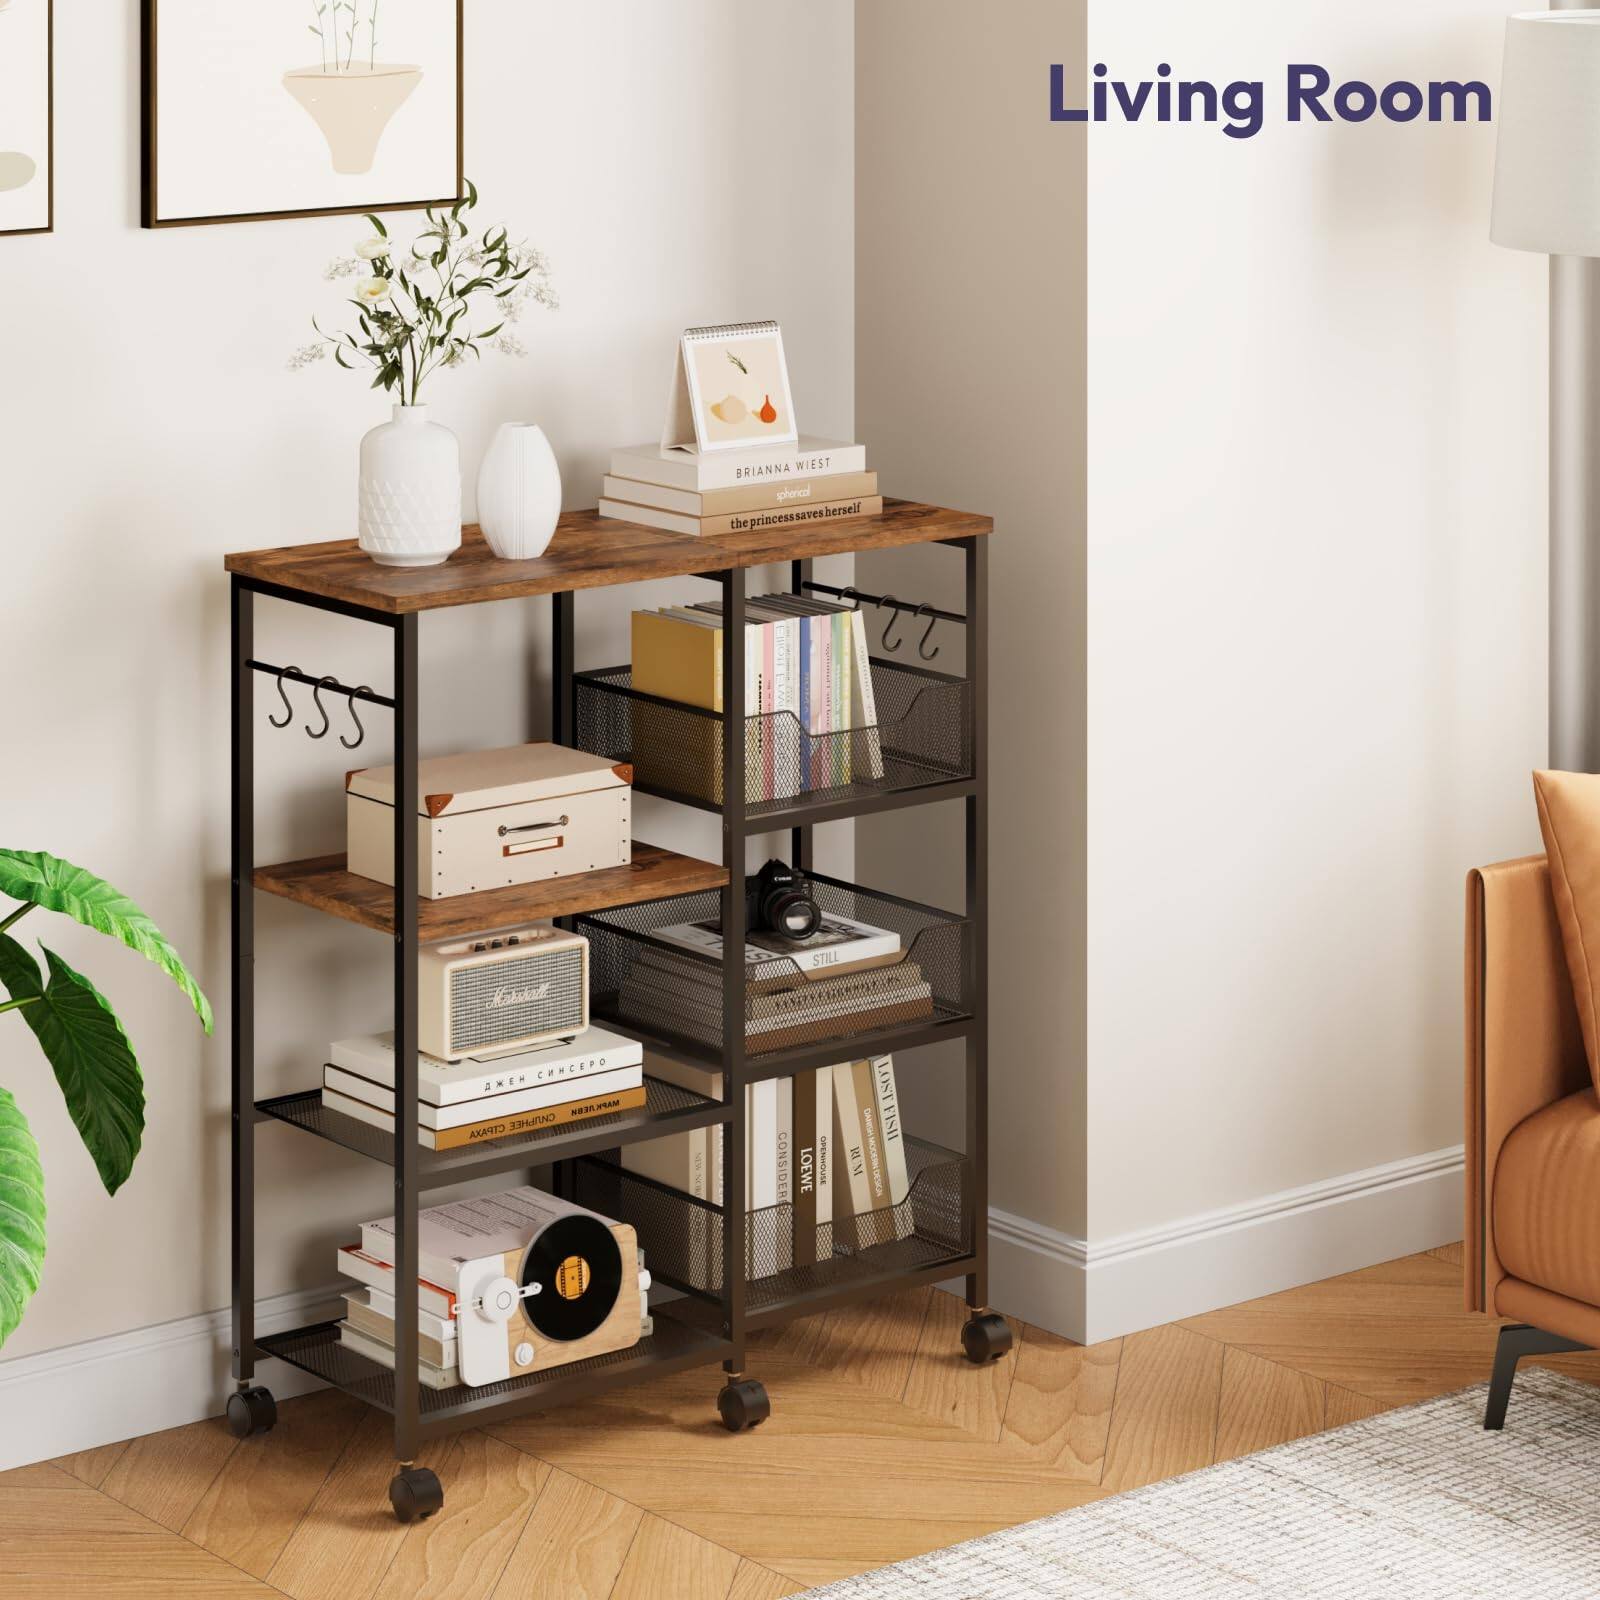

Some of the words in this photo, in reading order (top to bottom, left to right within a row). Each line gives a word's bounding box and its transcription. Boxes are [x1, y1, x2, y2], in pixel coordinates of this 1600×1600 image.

[736, 463, 791, 479] BRIANNA
[796, 457, 831, 471] WIEST
[730, 517, 749, 530] the
[749, 513, 795, 530] princess
[795, 510, 824, 522] saves
[824, 501, 862, 518] herself
[812, 951, 840, 967] STILL
[485, 982, 551, 1009] Marshall
[484, 1073, 526, 1092] ДЖЕН
[537, 1058, 607, 1080] СИНСЕРО
[878, 1061, 894, 1102] LOST
[884, 1107, 899, 1142] FISH
[801, 1147, 813, 1194] LOEWE
[850, 1146, 863, 1177] RUM
